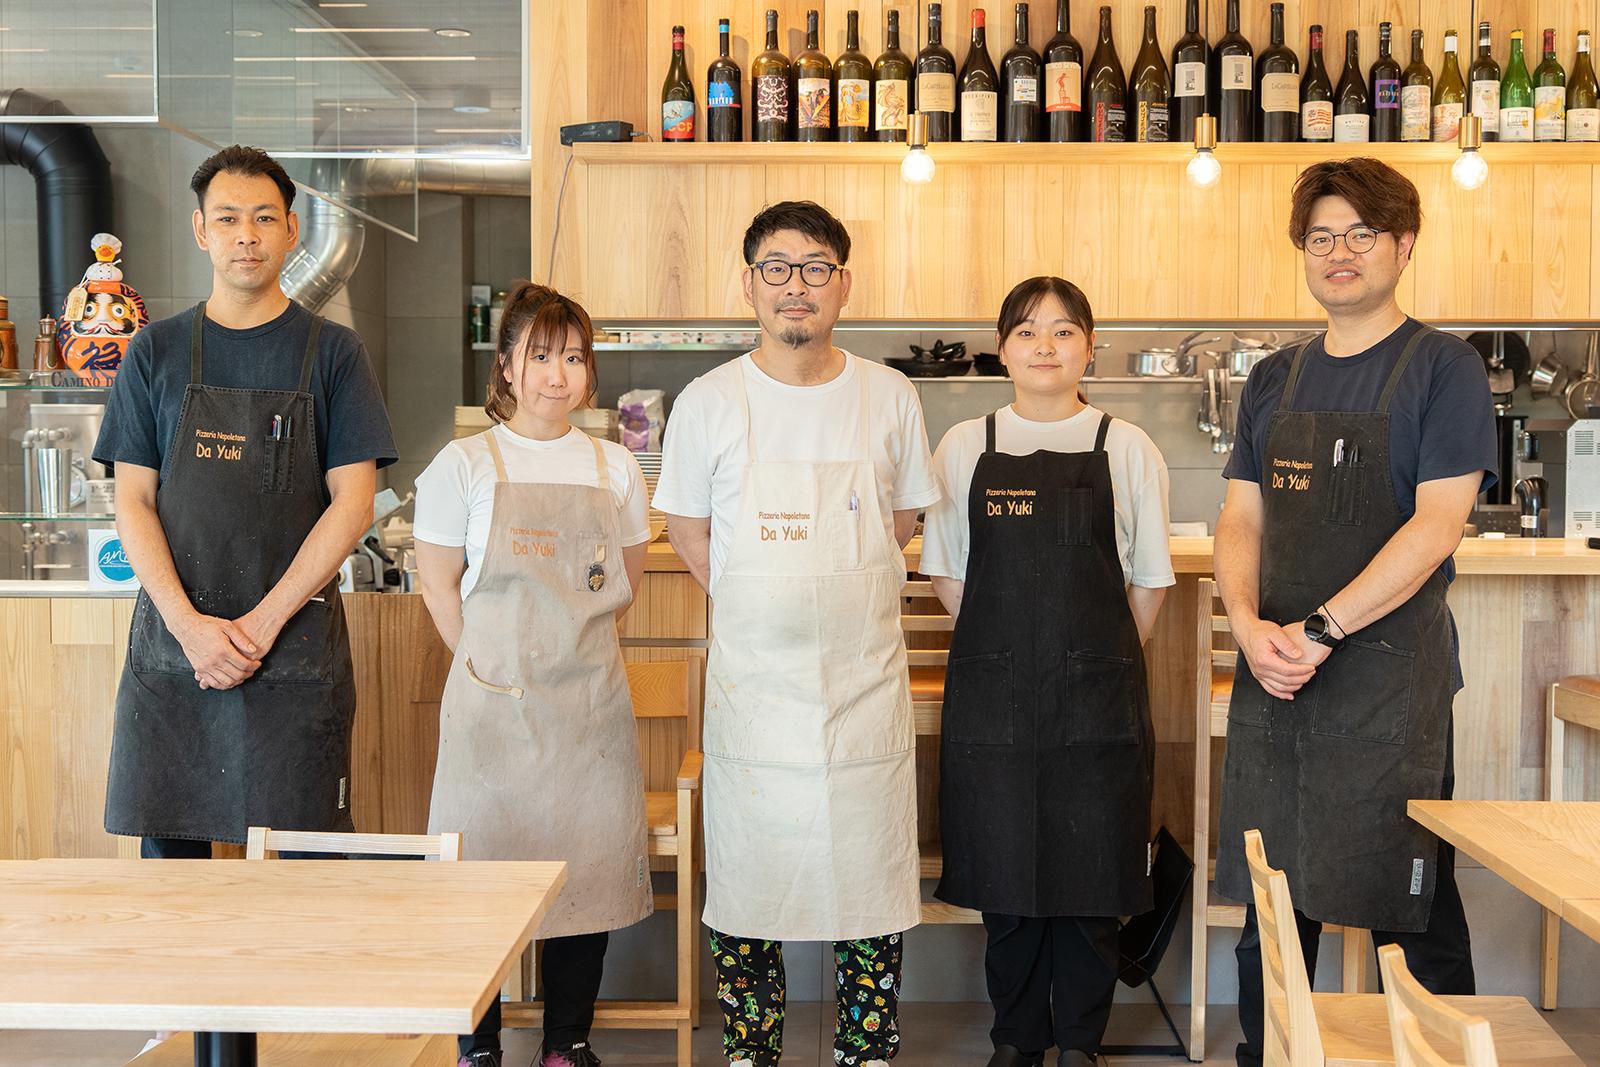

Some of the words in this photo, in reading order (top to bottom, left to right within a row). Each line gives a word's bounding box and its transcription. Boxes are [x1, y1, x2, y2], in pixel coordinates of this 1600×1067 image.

[51, 371, 101, 388] CAMINO
[195, 429, 216, 439] Pizzeria
[217, 431, 246, 442] Napoletana
[196, 442, 212, 458] Da
[217, 444, 242, 460] Yuki
[1272, 472, 1284, 489] Da
[1288, 473, 1311, 491] Yuki
[985, 488, 1006, 496] Pizzeria
[1006, 488, 1036, 498] Napoletana
[758, 511, 779, 520] Pizzeria
[780, 511, 810, 522] Napoletana
[987, 500, 1002, 517] Da
[1006, 500, 1033, 516] Yuki
[509, 527, 530, 535] Pizzeria
[531, 528, 558, 538] Napoletana
[760, 525, 777, 541] Da
[781, 525, 808, 541] Yuki
[512, 540, 529, 556] Da
[532, 541, 555, 557] Yuki
